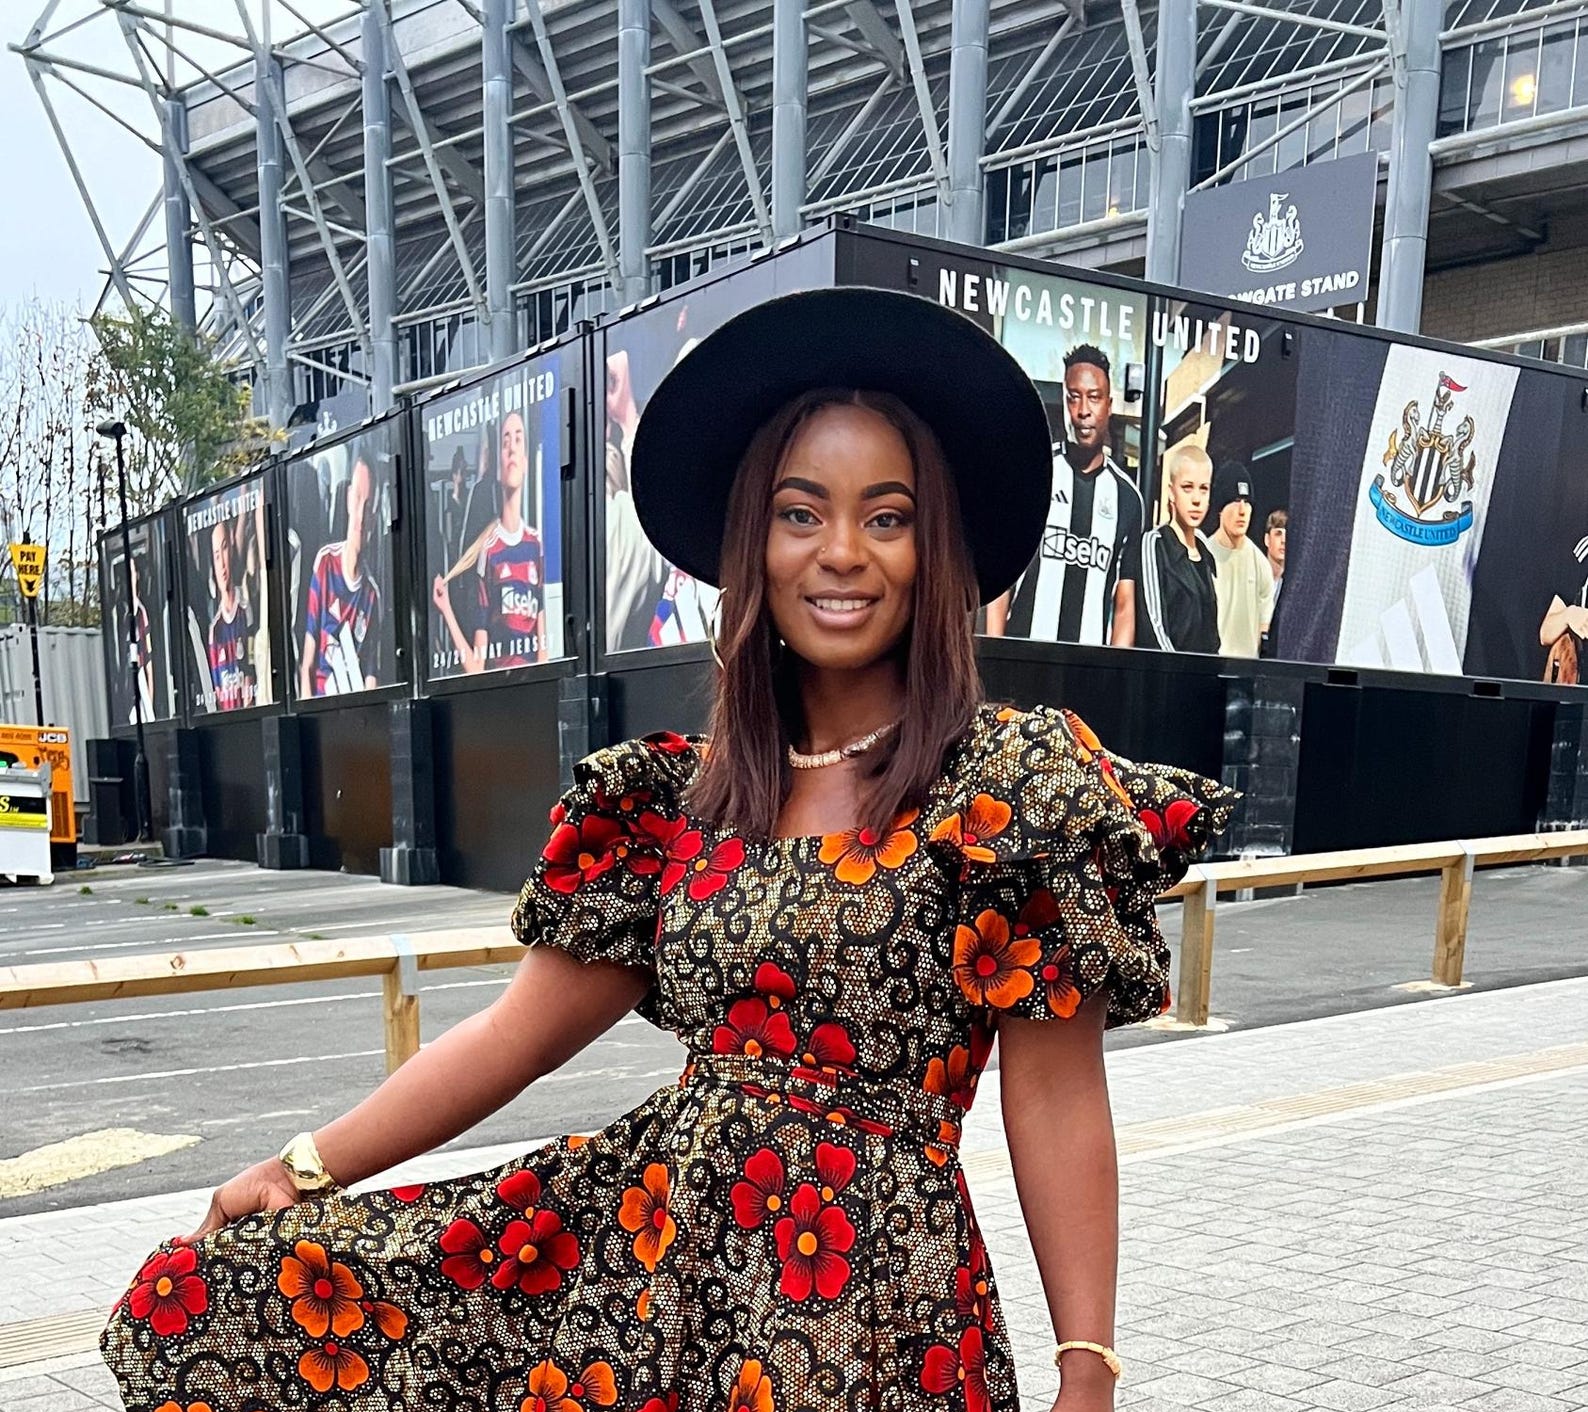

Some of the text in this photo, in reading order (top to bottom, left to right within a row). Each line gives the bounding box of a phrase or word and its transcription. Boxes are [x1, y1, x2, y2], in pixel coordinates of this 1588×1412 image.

[1301, 270, 1360, 298] STAND
[939, 268, 1261, 364] NEWCASTLE UNITED
[428, 371, 555, 442] NEWCASTLE UNITED
[1381, 507, 1456, 541] NEWCASTLE UNITED
[20, 550, 36, 562] PAY
[1064, 534, 1111, 572] sela
[18, 564, 40, 576] HERE
[509, 633, 554, 657] JERSE
[38, 732, 68, 743] JCB
